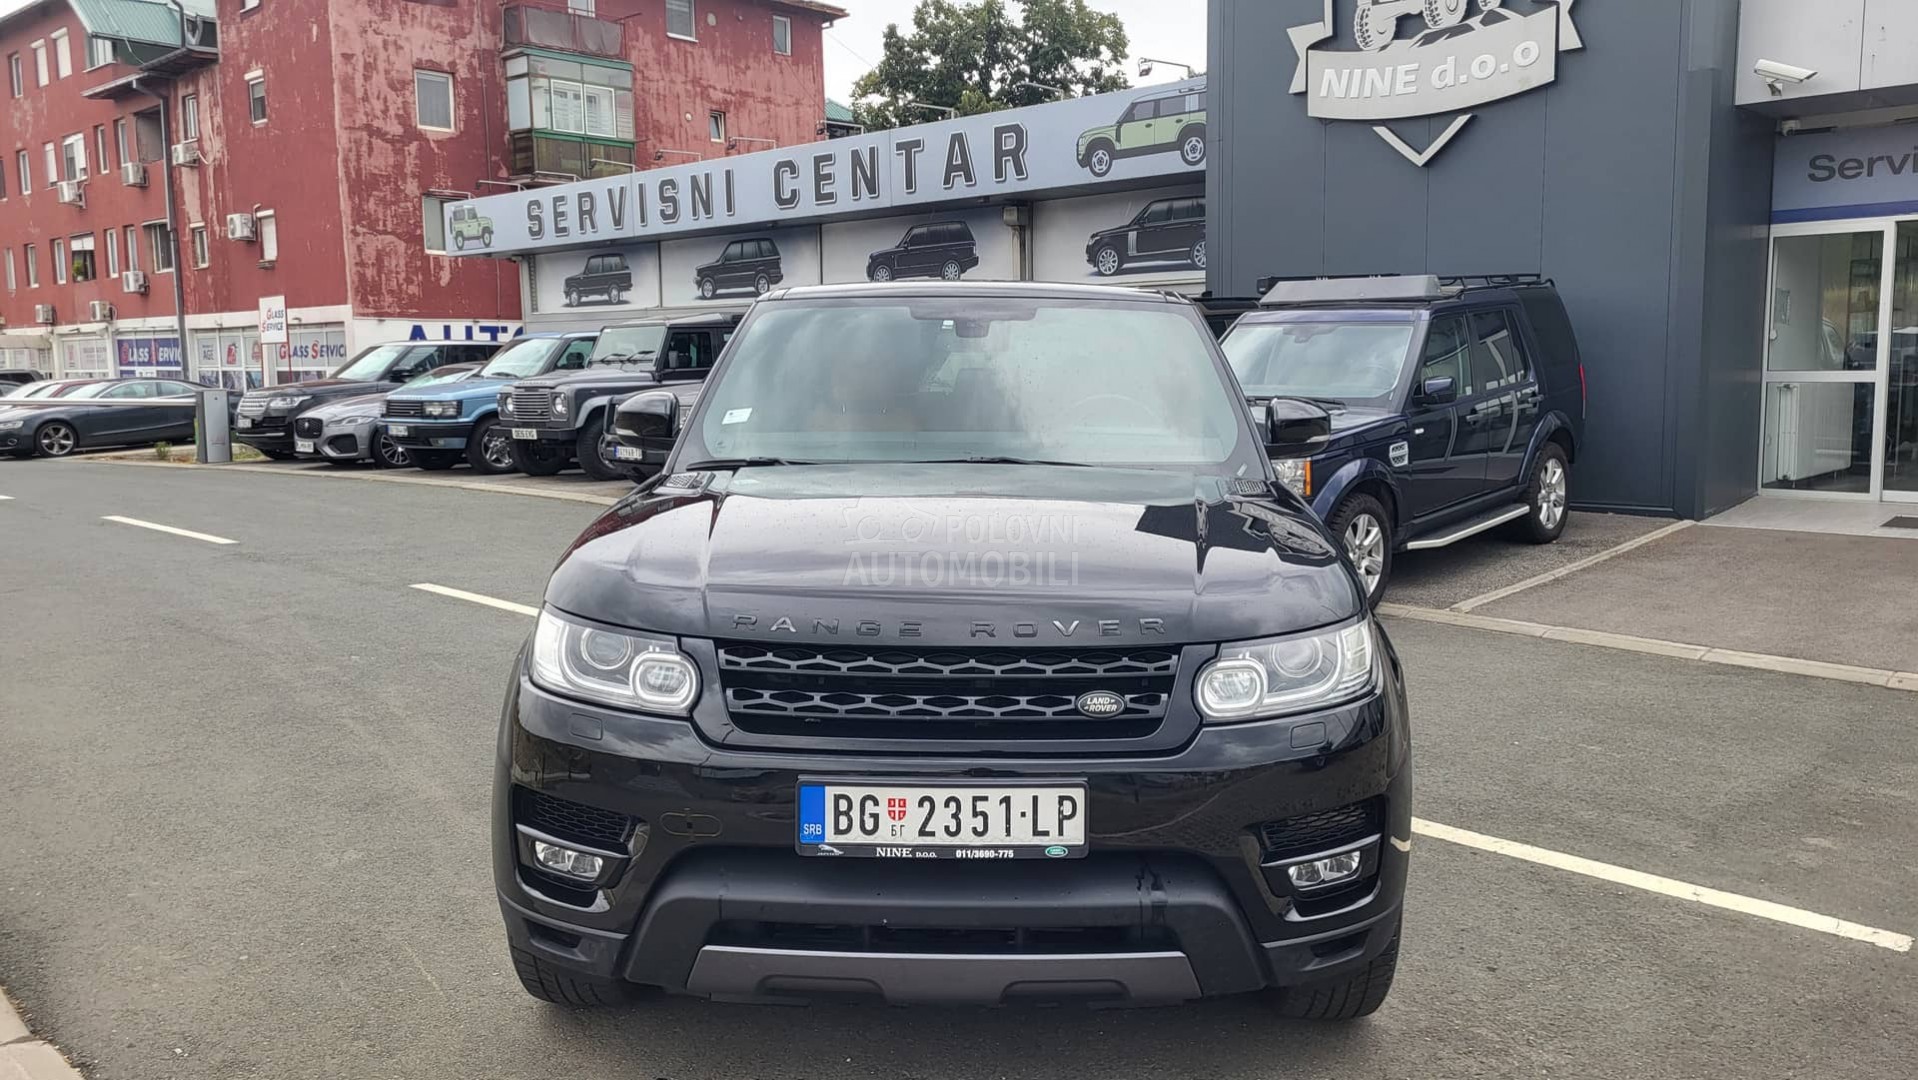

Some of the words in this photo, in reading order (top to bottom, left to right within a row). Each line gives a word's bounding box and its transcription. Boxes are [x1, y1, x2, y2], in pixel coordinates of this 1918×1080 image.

[1320, 63, 1419, 98] NINE
[1431, 40, 1540, 89] d.o.o
[526, 167, 737, 240] SERVISNI
[772, 122, 1029, 210] CENTAR
[732, 614, 923, 637] RANGE
[970, 617, 1167, 638] ROVER
[803, 824, 822, 836] SRB
[832, 793, 880, 836] BG
[876, 847, 912, 858] NINE
[955, 849, 1014, 859] 011/3690-775
